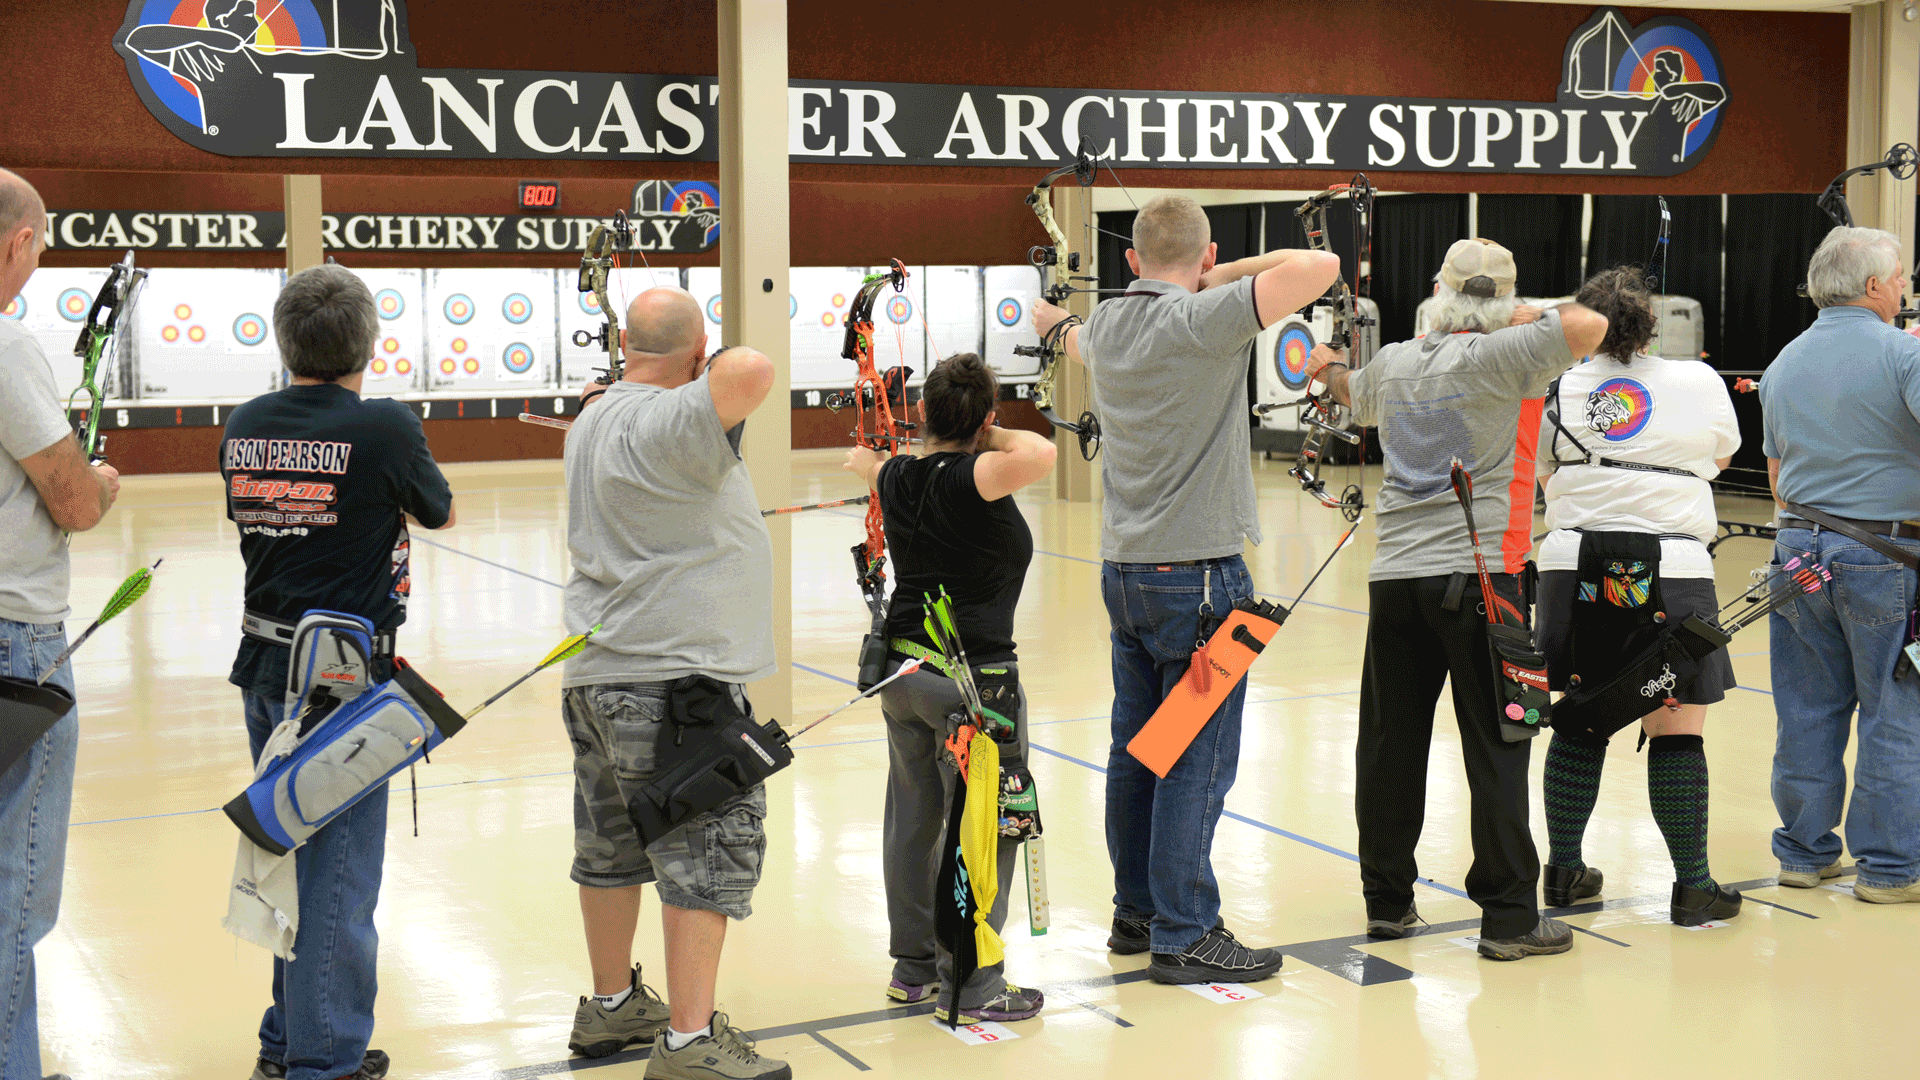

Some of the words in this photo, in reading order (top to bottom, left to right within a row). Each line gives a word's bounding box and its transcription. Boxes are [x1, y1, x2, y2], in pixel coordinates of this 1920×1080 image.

[273, 71, 906, 158] LANCASER
[934, 91, 1347, 165] ARCHERY
[1367, 103, 1649, 170] SUPPLY
[523, 185, 557, 206] 800
[276, 214, 505, 250] RCHERY
[516, 217, 681, 250] SUPLY
[553, 397, 565, 414] 8
[805, 390, 821, 406] 10
[116, 409, 130, 427] 5
[421, 402, 431, 419] 7
[225, 438, 267, 471] ASON
[265, 439, 352, 474] PEARSON
[1517, 670, 1548, 683] EASTON
